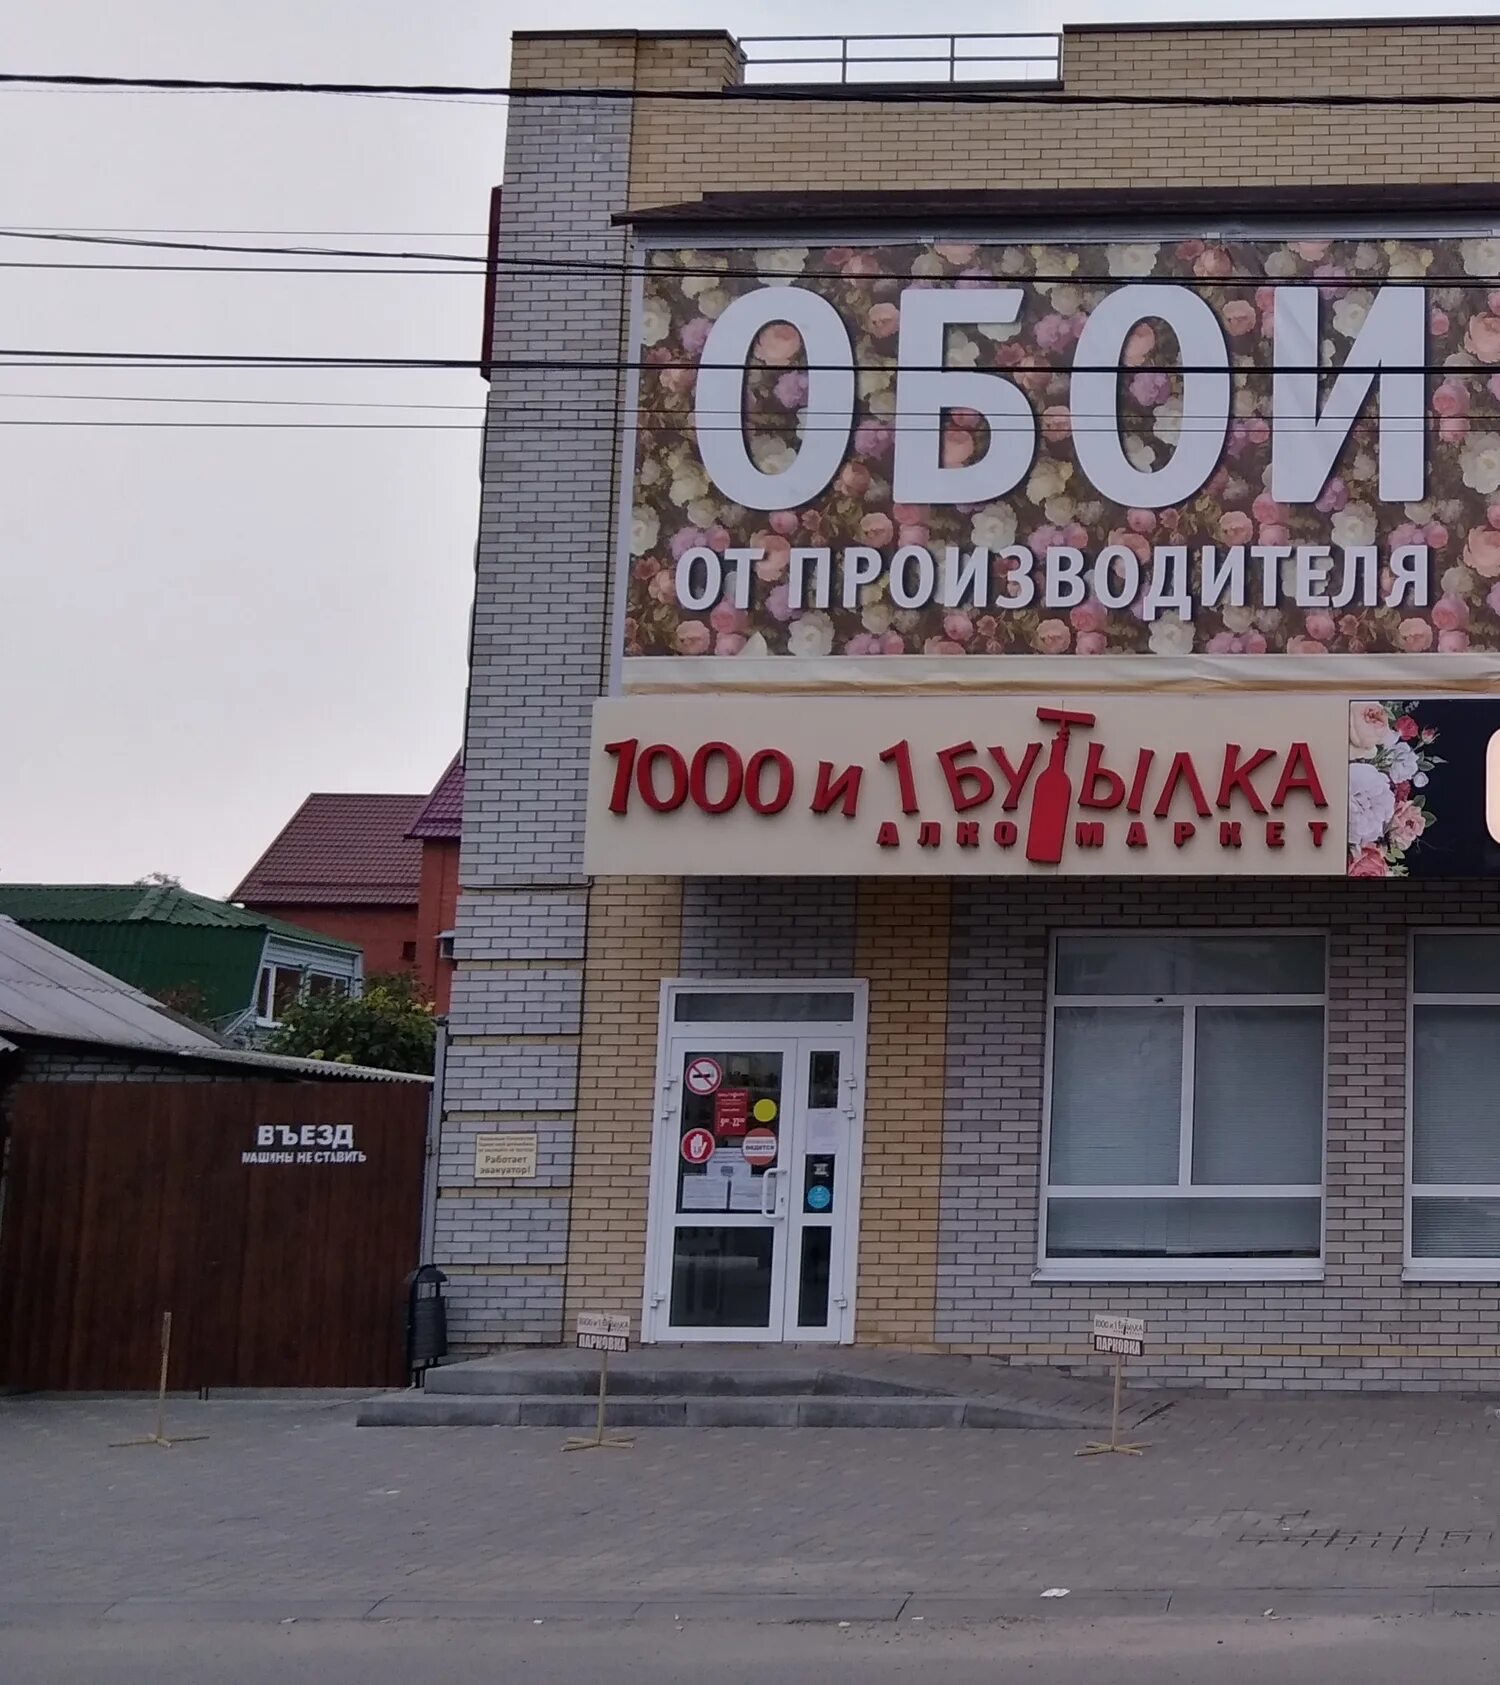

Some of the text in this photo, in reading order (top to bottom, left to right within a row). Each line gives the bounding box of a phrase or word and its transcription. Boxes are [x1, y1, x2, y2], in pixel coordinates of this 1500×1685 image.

[695, 284, 1427, 511] ОБОИ
[674, 544, 1430, 621] ОТ ПРОИЗВОДИТЕЛЯ
[604, 738, 795, 815] 1000
[879, 739, 920, 815] 1
[257, 1124, 354, 1149] ВЪЕЗД
[296, 1151, 313, 1163] НЕ
[313, 1150, 367, 1163] СТАВИТЬ
[485, 1155, 528, 1164] Работает
[579, 1334, 627, 1351] ПАРКОВКА
[1096, 1336, 1141, 1355] ПАРКОВКА
